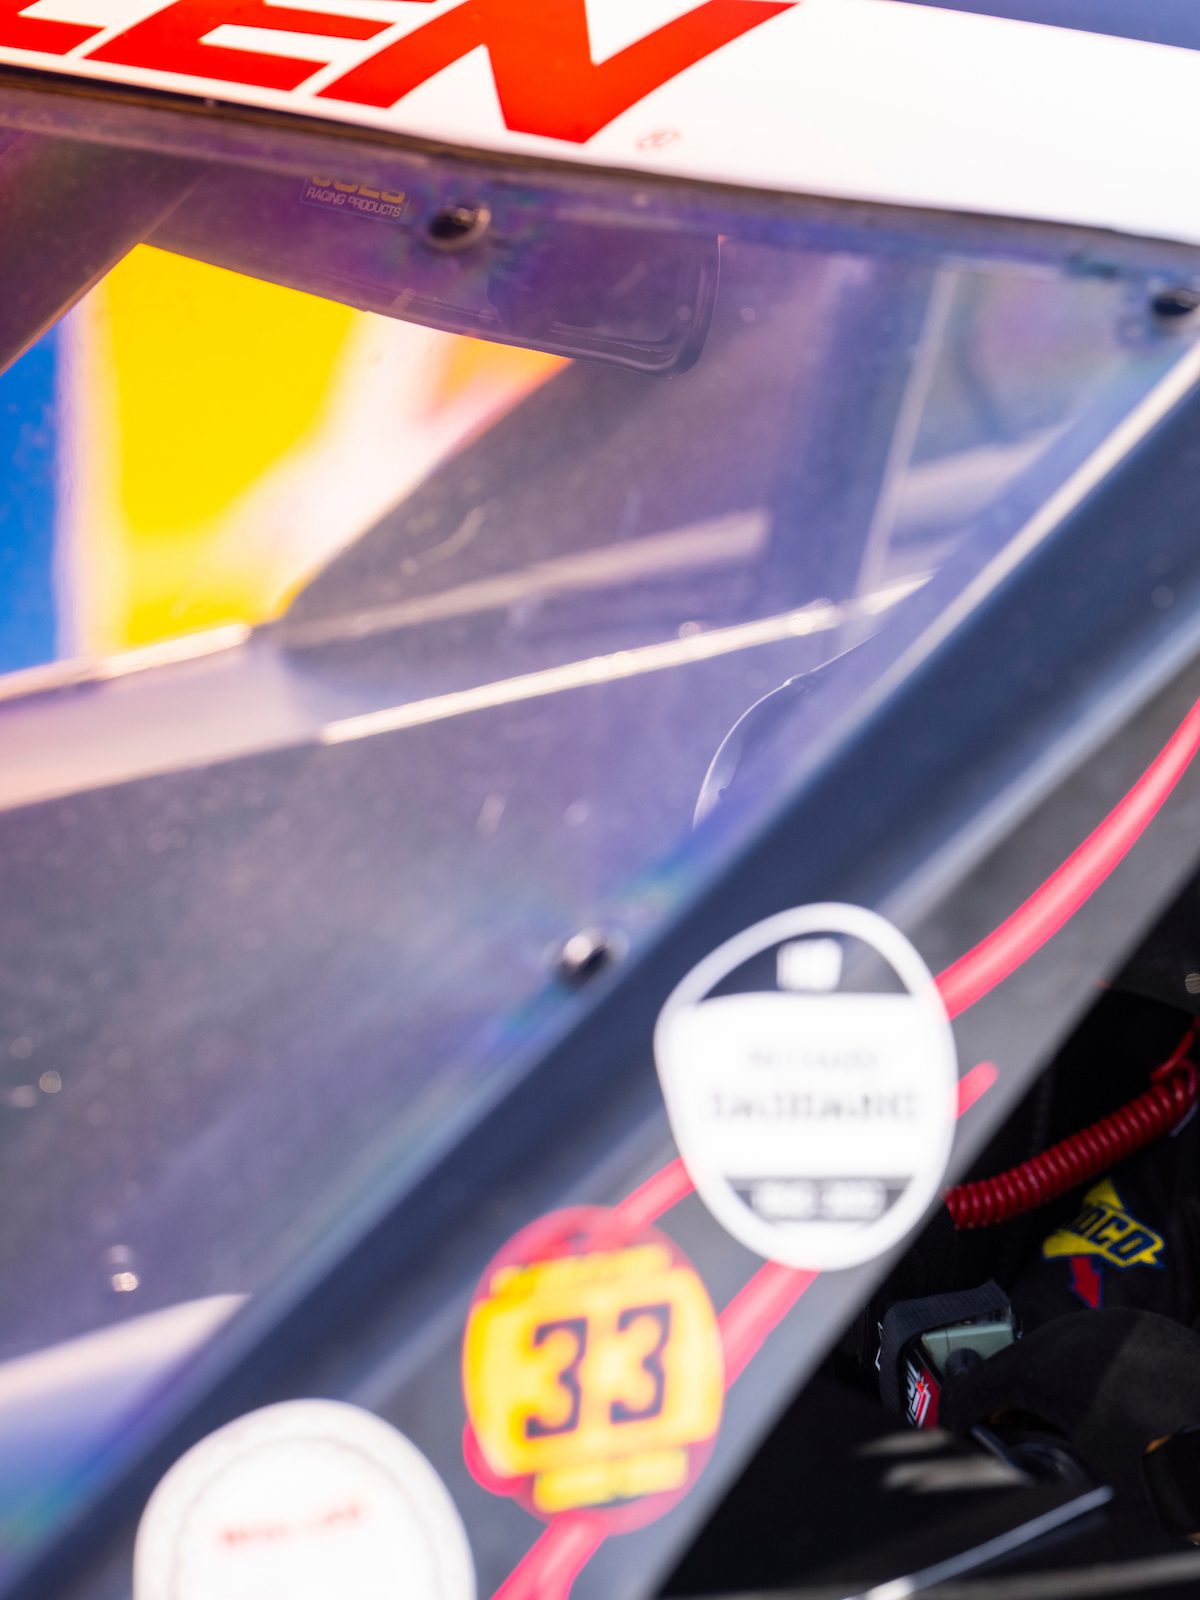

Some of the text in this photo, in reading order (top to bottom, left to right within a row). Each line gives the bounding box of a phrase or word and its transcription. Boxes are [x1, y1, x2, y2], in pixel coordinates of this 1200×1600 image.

[306, 187, 346, 205] RACING
[347, 196, 402, 217] PRODUCTS
[526, 1303, 672, 1440] 33
